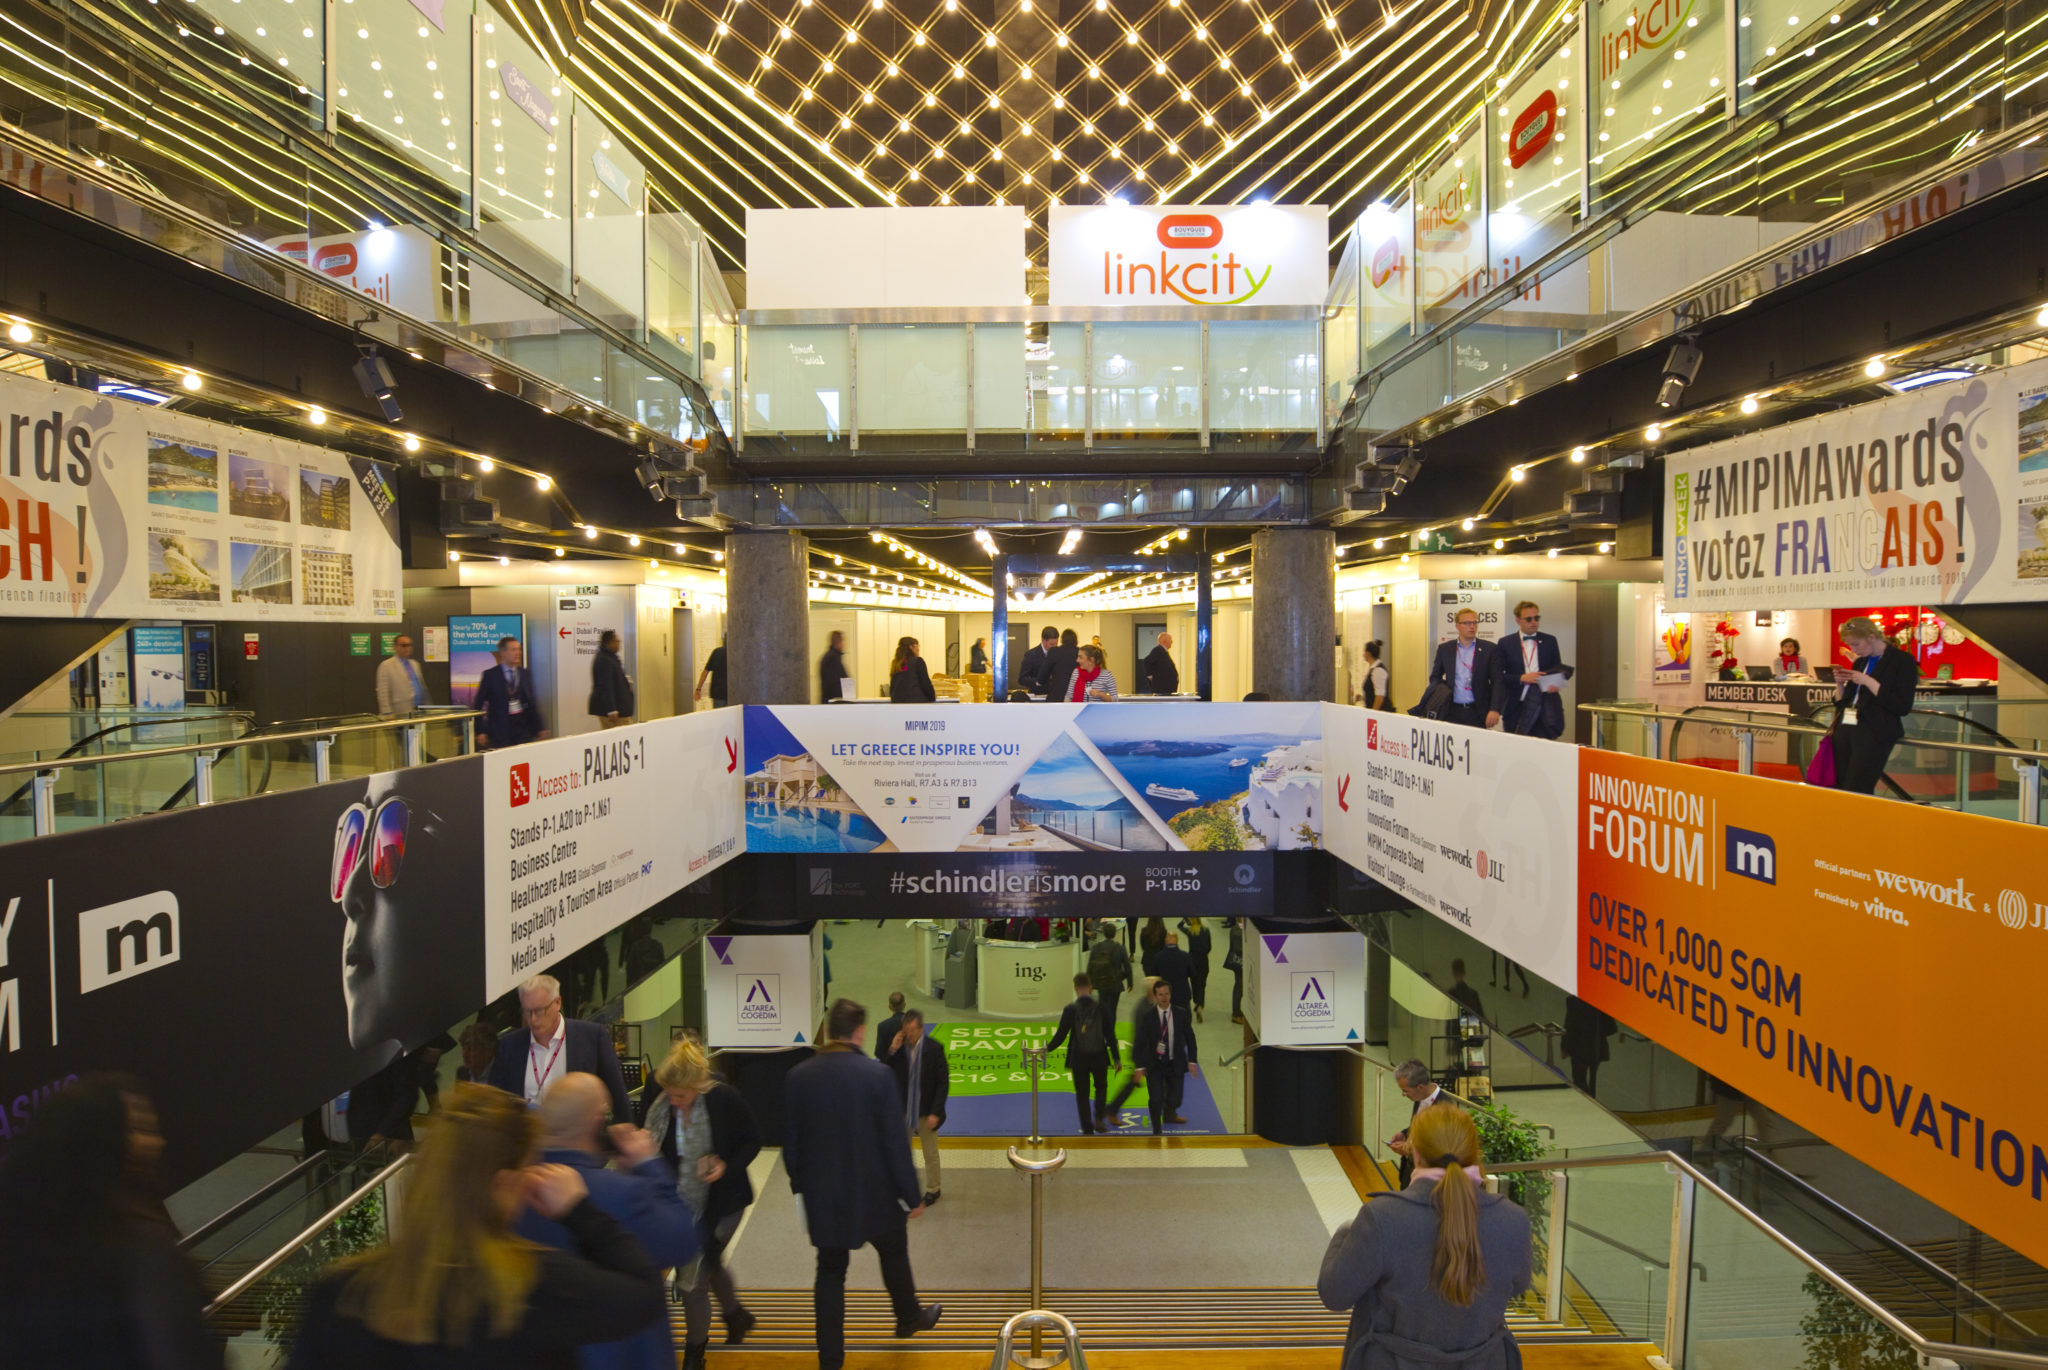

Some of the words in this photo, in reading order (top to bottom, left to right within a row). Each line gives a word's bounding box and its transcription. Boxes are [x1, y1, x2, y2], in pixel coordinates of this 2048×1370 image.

[1104, 251, 1272, 305] linkcity
[0, 411, 92, 486] rds
[1694, 417, 1965, 522] #MIPIMAwards
[1677, 476, 1688, 533] WEEK
[1677, 540, 1687, 594] IMMO
[1692, 529, 1765, 582] votez
[40, 590, 88, 603] finalists
[1789, 582, 1826, 593] finalistes
[1880, 577, 1906, 589] Mipim
[1910, 574, 1942, 586] Awards
[472, 622, 488, 630] 70%
[489, 622, 497, 630] of
[576, 627, 592, 635] Dubai
[1447, 612, 1498, 624] SCES
[1708, 686, 1754, 701] MEMBER
[1757, 687, 1787, 702] DESK
[905, 720, 929, 731] MIPIM
[930, 720, 946, 731] 2019
[536, 771, 568, 800] Access
[570, 768, 582, 789] to:
[584, 738, 631, 786] PALAIS
[634, 736, 645, 770] -1
[832, 744, 857, 756] LET
[860, 744, 916, 756] GREECE
[920, 744, 976, 756] INSPIRE
[980, 744, 1020, 756] YOU!
[842, 759, 857, 767] Take
[858, 759, 868, 767] the
[898, 759, 915, 767] Invest
[922, 760, 956, 768] prosperous
[956, 759, 982, 767] business
[1380, 736, 1400, 757] Access
[1412, 728, 1454, 771] PALAIS
[1458, 738, 1471, 776] -1
[874, 778, 899, 788] Riviera
[901, 778, 918, 789] Hall,
[920, 778, 941, 788] R7.A3
[943, 778, 949, 788] &
[950, 778, 977, 788] R7.B13
[1368, 760, 1384, 781] Stands
[1405, 773, 1411, 790] to
[1412, 774, 1434, 798] P-1.N61
[1368, 784, 1380, 803] Coral
[1380, 789, 1395, 809] Room
[1589, 772, 1704, 828] INNOVATION
[511, 822, 541, 850] Stands
[542, 808, 574, 839] P-1.A20
[575, 810, 583, 826] to
[584, 798, 611, 824] P-1.N61
[511, 852, 550, 882] Business
[552, 840, 577, 863] Centre
[1367, 808, 1392, 831] Innovation
[1392, 818, 1410, 841] Forum
[1440, 844, 1473, 869] wework
[1488, 859, 1505, 883] JLL
[1367, 830, 1382, 852] MIPIM
[1382, 838, 1407, 866] Corporate
[1408, 850, 1425, 874] Stand
[1589, 805, 1704, 886] FORUM
[511, 880, 558, 913] Healthcare
[559, 868, 577, 892] Area
[890, 869, 1126, 894] #schindlerismore
[1146, 868, 1181, 877] BOOTH
[1146, 880, 1201, 892] P-1.B50
[1814, 858, 1839, 873] Official
[1840, 866, 1872, 882] partners
[1874, 868, 1977, 913] wework
[1984, 903, 1991, 914] &
[511, 908, 557, 944] Hospitality
[558, 898, 565, 918] &
[566, 888, 596, 916] Tourism
[597, 878, 613, 901] Area
[641, 860, 653, 878] PKF
[1388, 864, 1406, 892] Lounge
[1440, 900, 1472, 928] wework
[1814, 888, 1849, 908] Furnished
[1850, 897, 1860, 911] by
[1864, 896, 1910, 927] vitra.
[511, 948, 538, 975] Media
[539, 936, 556, 960] Hub
[1016, 962, 1047, 982] ing.
[1589, 892, 1648, 948] OVER
[1655, 918, 1723, 980] 1,000
[1730, 949, 1802, 1017] SQM
[740, 1012, 778, 1020] COGEDIM
[743, 1004, 776, 1012] ALTAREA
[1294, 1010, 1332, 1018] COGEDIM
[1296, 1002, 1329, 1010] ALTAREA
[1589, 936, 1727, 1036] DEDICATED
[1736, 1004, 1777, 1061] TO
[948, 1053, 1018, 1061] Please
[948, 1062, 1010, 1071] Stand
[949, 1073, 998, 1083] C16
[1008, 1072, 1027, 1081] &
